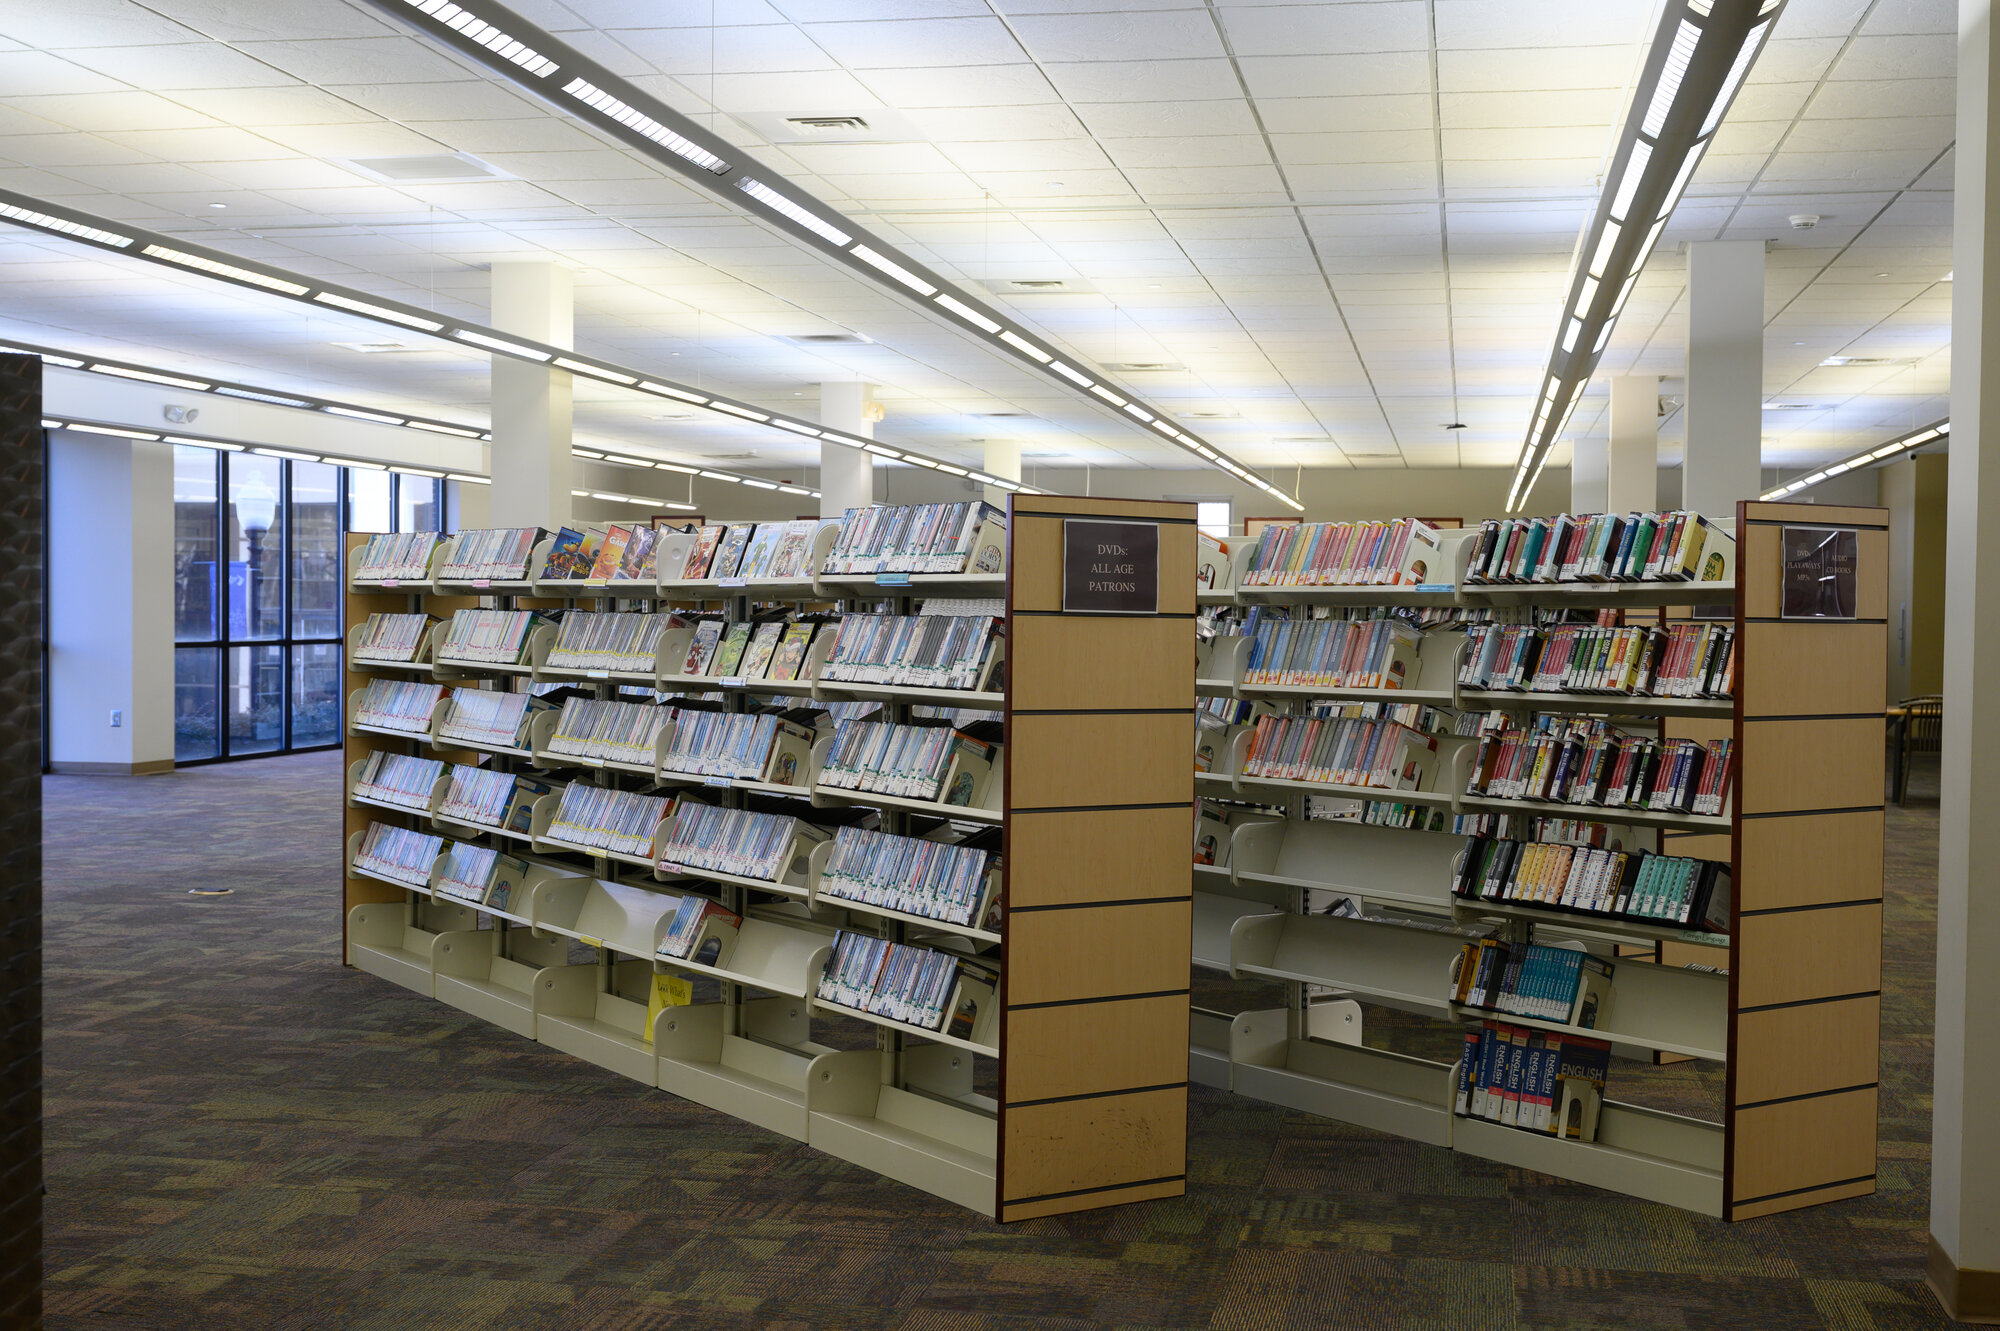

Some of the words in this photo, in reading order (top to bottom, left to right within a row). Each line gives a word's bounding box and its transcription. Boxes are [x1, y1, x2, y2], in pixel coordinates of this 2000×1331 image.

[1097, 544, 1128, 555] DVDs:
[1090, 563, 1111, 574] ALL
[1113, 564, 1135, 575] AGE
[1787, 561, 1821, 570] PLAYAWAYS
[1089, 581, 1136, 593] PATRONS
[1495, 1044, 1506, 1085] ENGLISH
[1511, 1049, 1523, 1090] ENGLISH
[1528, 1051, 1540, 1092] ENGLISH
[1545, 1054, 1557, 1094] ENGLISH
[1560, 1063, 1604, 1081] ENGLISH
[1459, 1063, 1469, 1090] English
